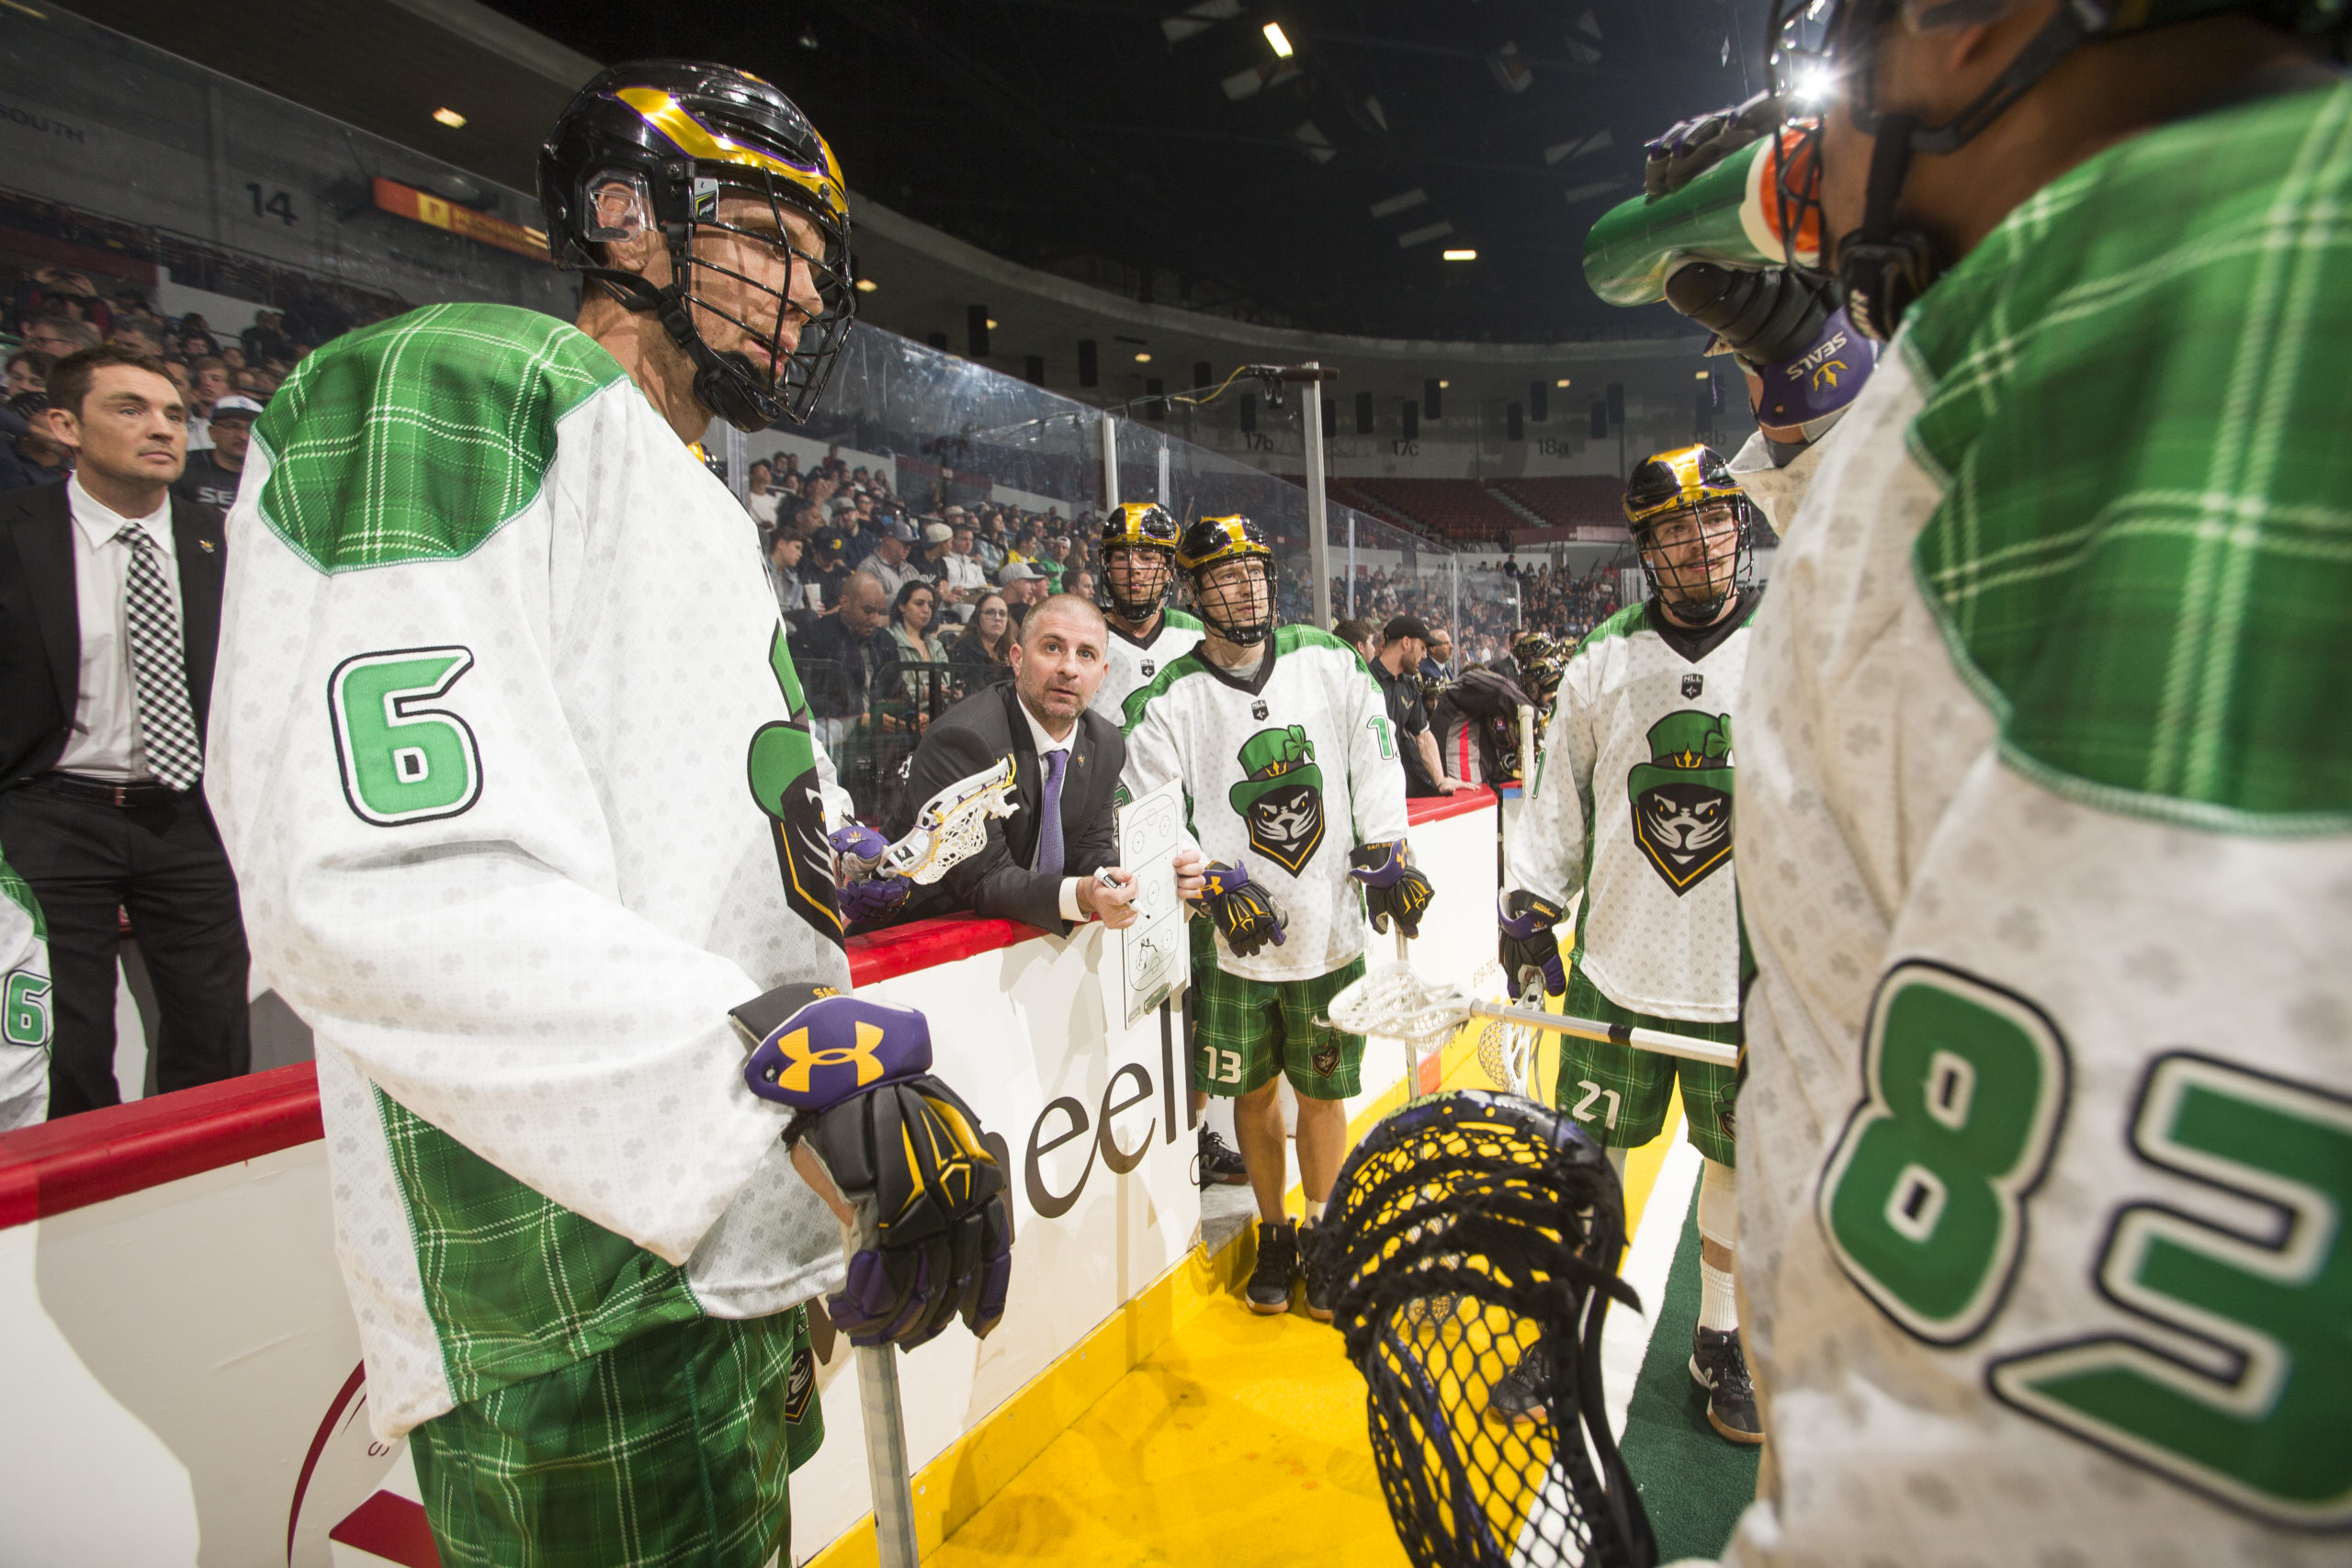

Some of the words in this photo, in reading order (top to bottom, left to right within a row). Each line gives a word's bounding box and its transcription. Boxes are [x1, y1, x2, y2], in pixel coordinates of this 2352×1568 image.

[245, 183, 300, 227] 14
[1786, 331, 1847, 380] SEALS
[1245, 434, 1274, 452] 17b
[1392, 440, 1419, 457] 17c
[1536, 438, 1569, 456] 18a
[1683, 673, 1702, 682] NLL
[1251, 700, 1268, 710] NLL
[327, 646, 483, 828] 6
[3, 970, 52, 1047] 6
[1204, 1046, 1241, 1084] 13
[1572, 1080, 1621, 1131] 21
